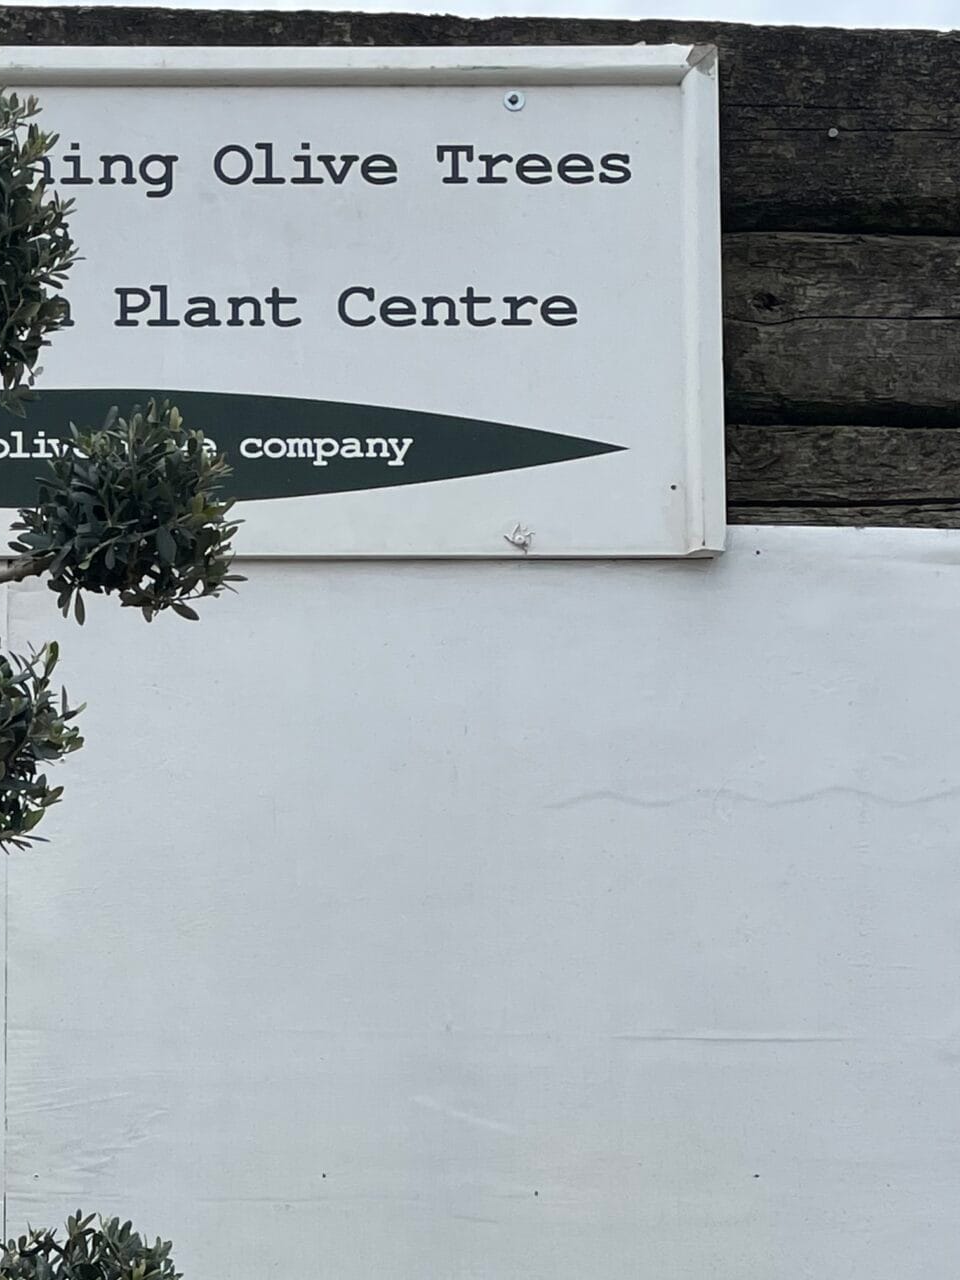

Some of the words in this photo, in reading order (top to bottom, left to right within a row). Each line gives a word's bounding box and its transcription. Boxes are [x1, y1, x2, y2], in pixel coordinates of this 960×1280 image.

[213, 142, 398, 186] Olive
[436, 144, 632, 185] Trees
[114, 284, 302, 328] Plant
[337, 286, 579, 328] Centre
[239, 436, 414, 466] company
